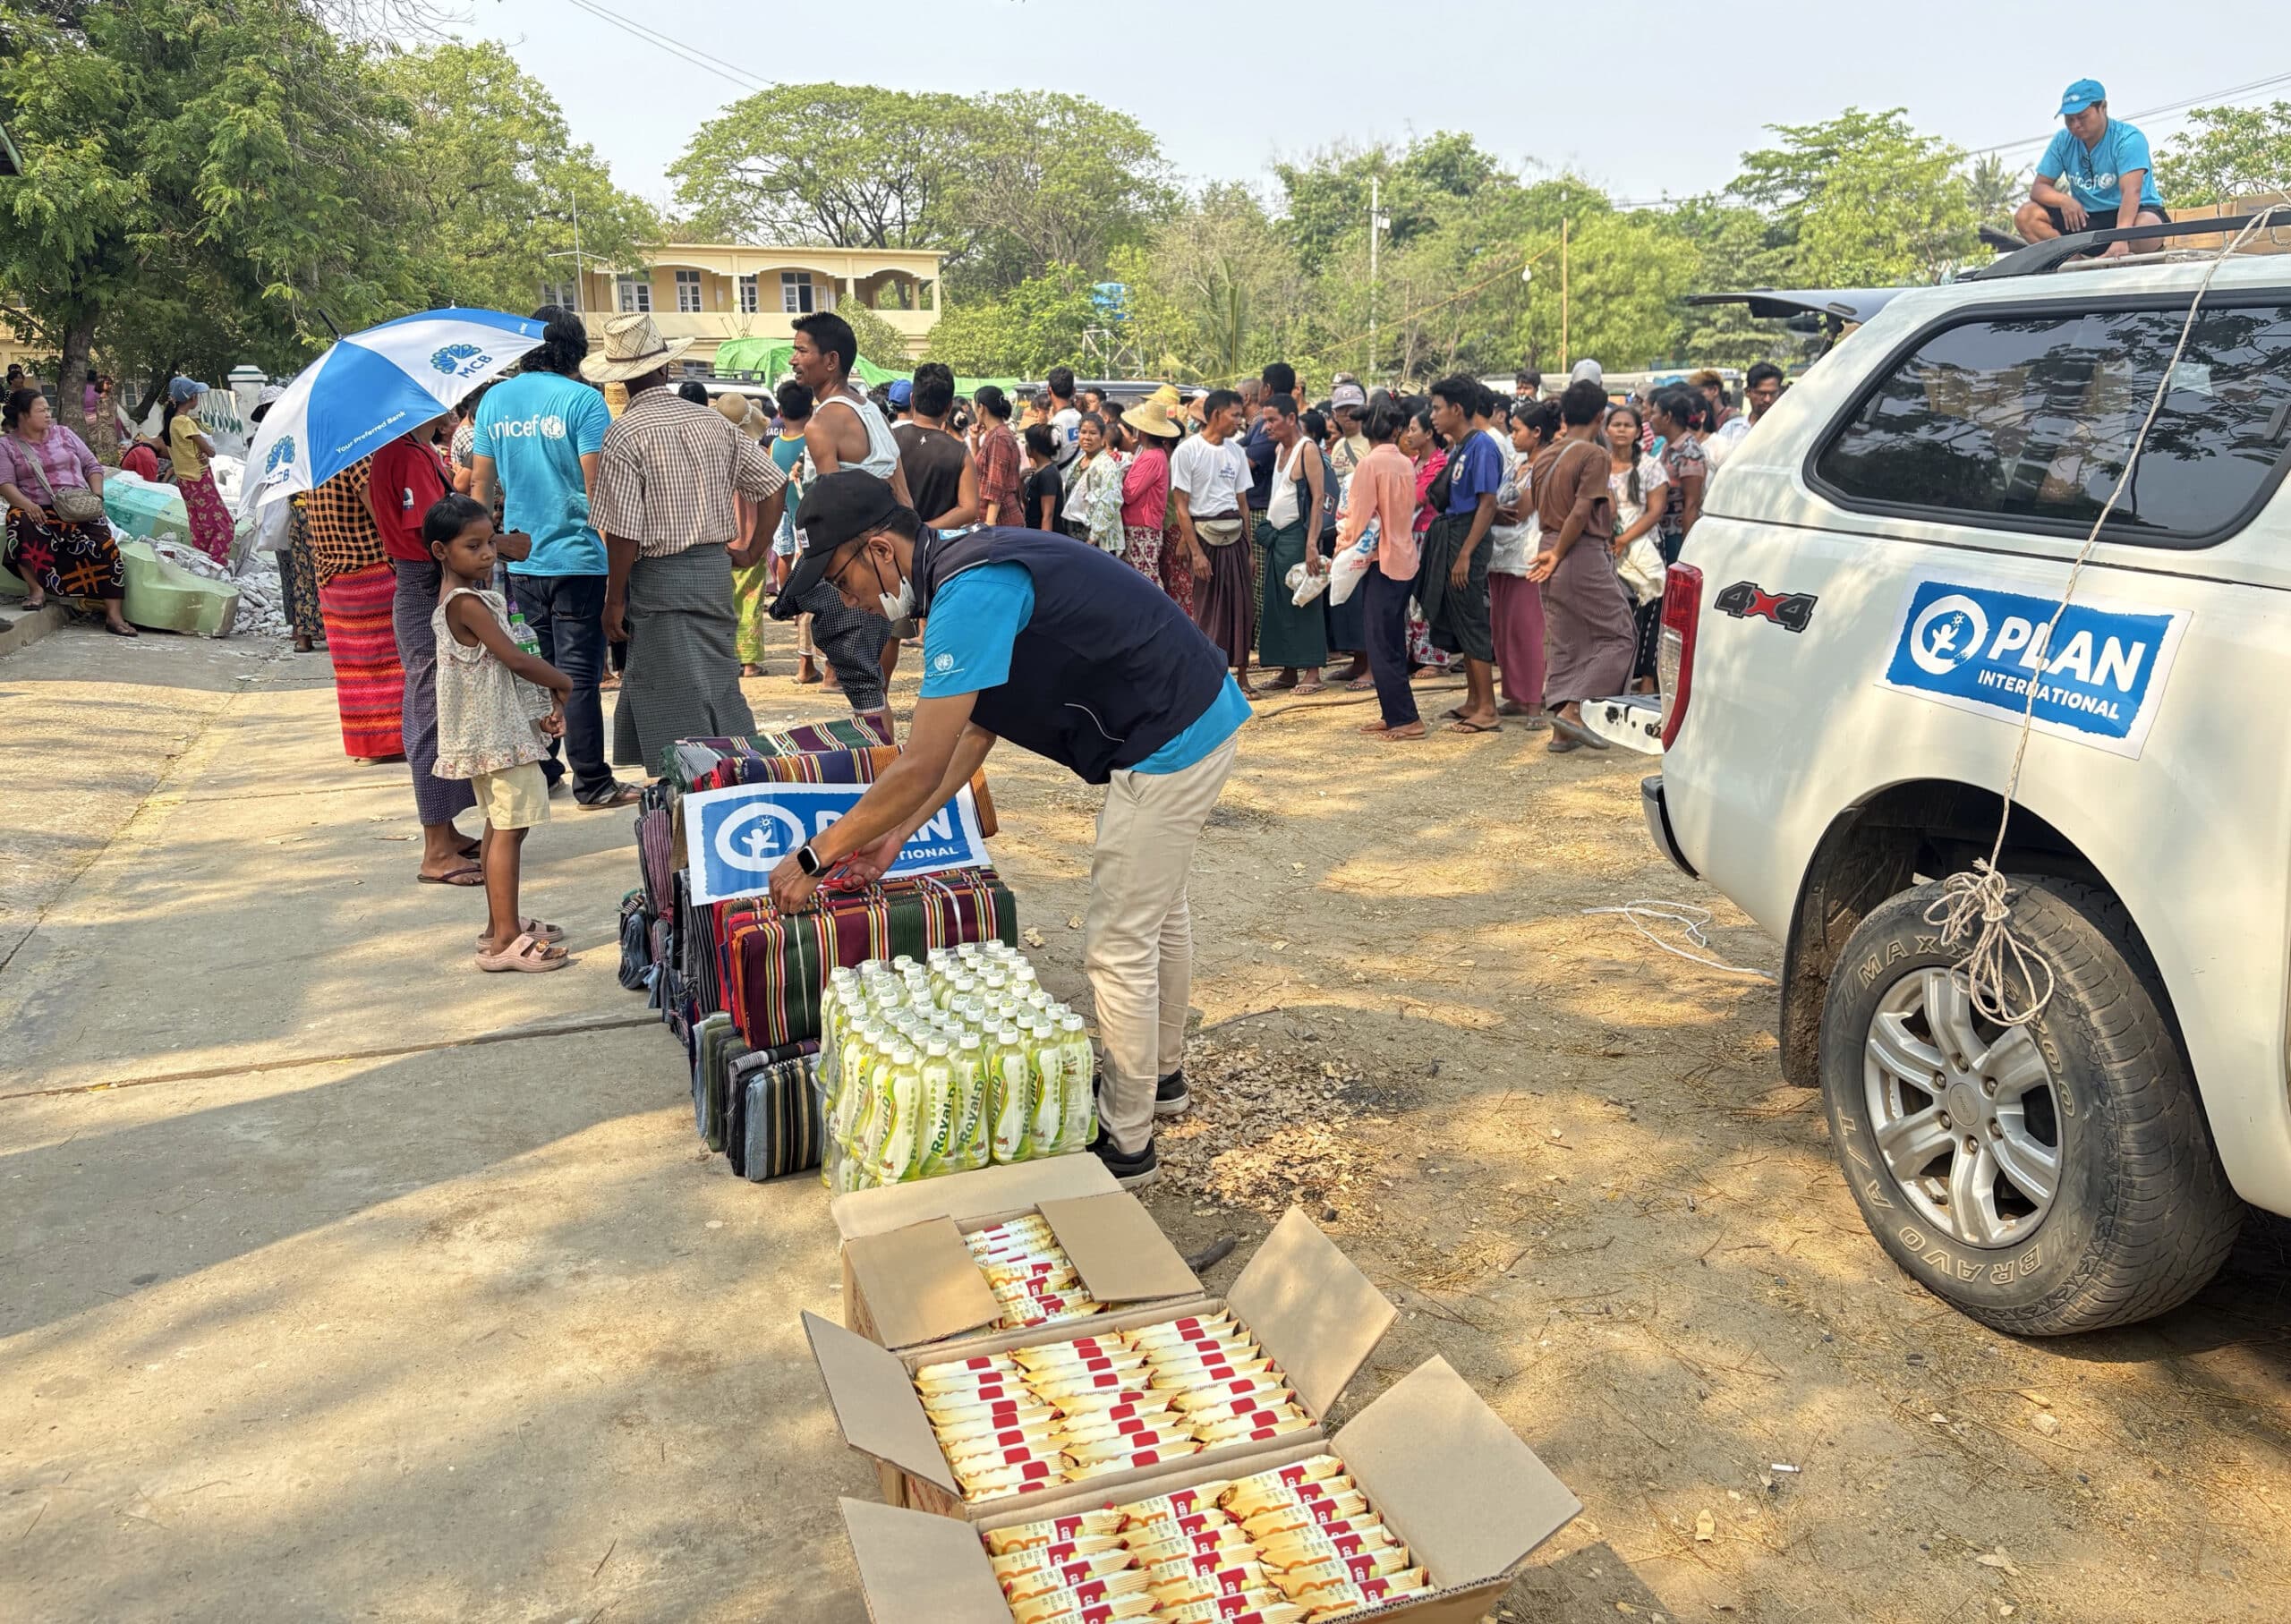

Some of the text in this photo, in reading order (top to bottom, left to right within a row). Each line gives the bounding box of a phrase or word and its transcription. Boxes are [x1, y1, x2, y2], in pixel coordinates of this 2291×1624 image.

[457, 355, 493, 378] MCB
[336, 411, 406, 454] Your Preferred Bank
[1987, 616, 2147, 693] PLAN
[931, 1085, 957, 1154] Royal-D
[958, 1080, 985, 1144] Royal-D
[1898, 1226, 2043, 1286] BRAVO
